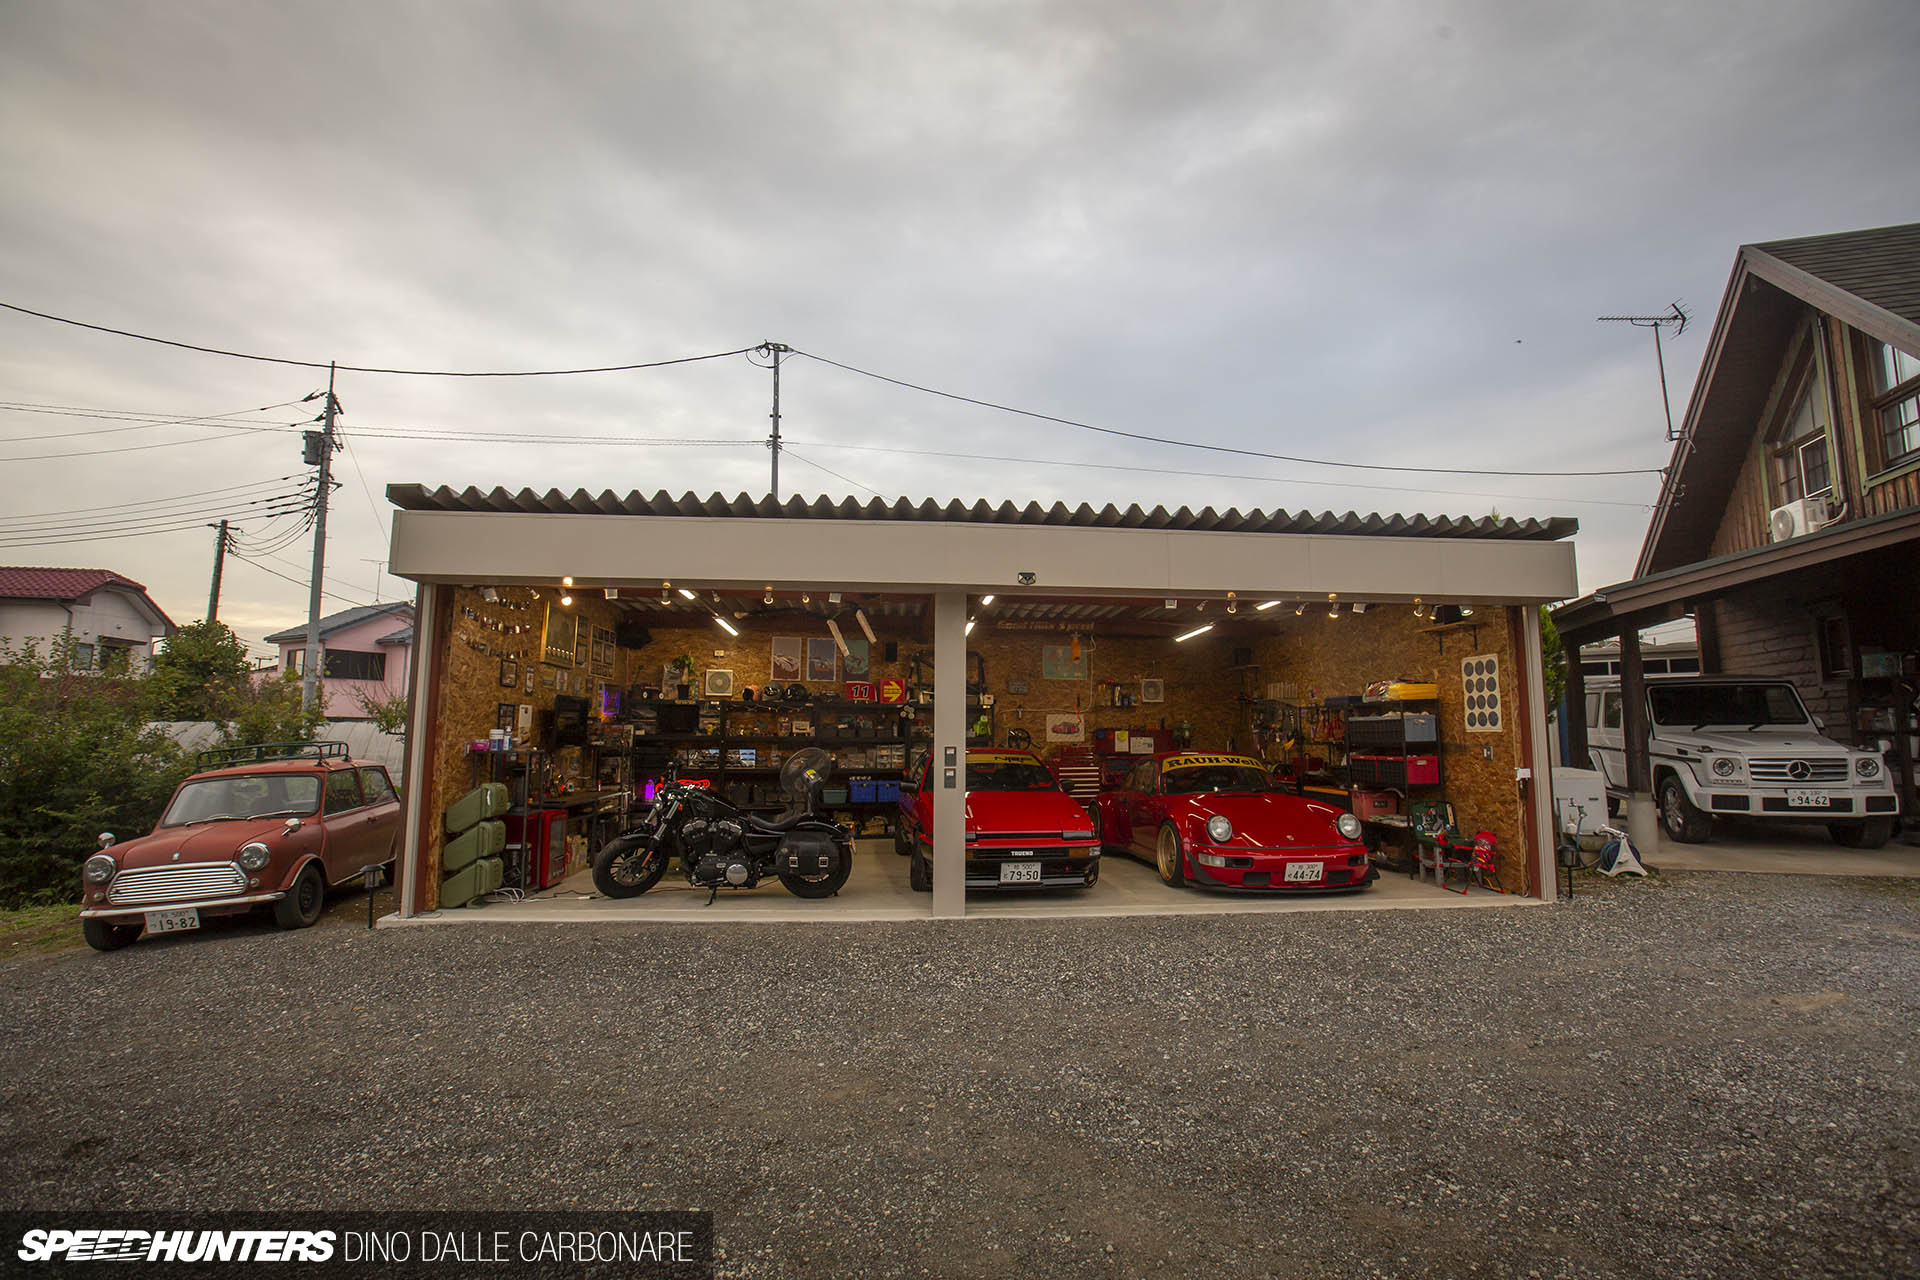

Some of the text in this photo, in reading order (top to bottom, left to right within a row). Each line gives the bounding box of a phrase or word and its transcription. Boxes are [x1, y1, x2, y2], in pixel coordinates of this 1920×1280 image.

[852, 685, 870, 698] 11
[1167, 757, 1262, 768] RAUH-Welt
[1797, 796, 1828, 805] 94-62
[1009, 870, 1039, 881] 79-50
[1293, 870, 1320, 880] 44-74
[159, 917, 197, 931] 19-82
